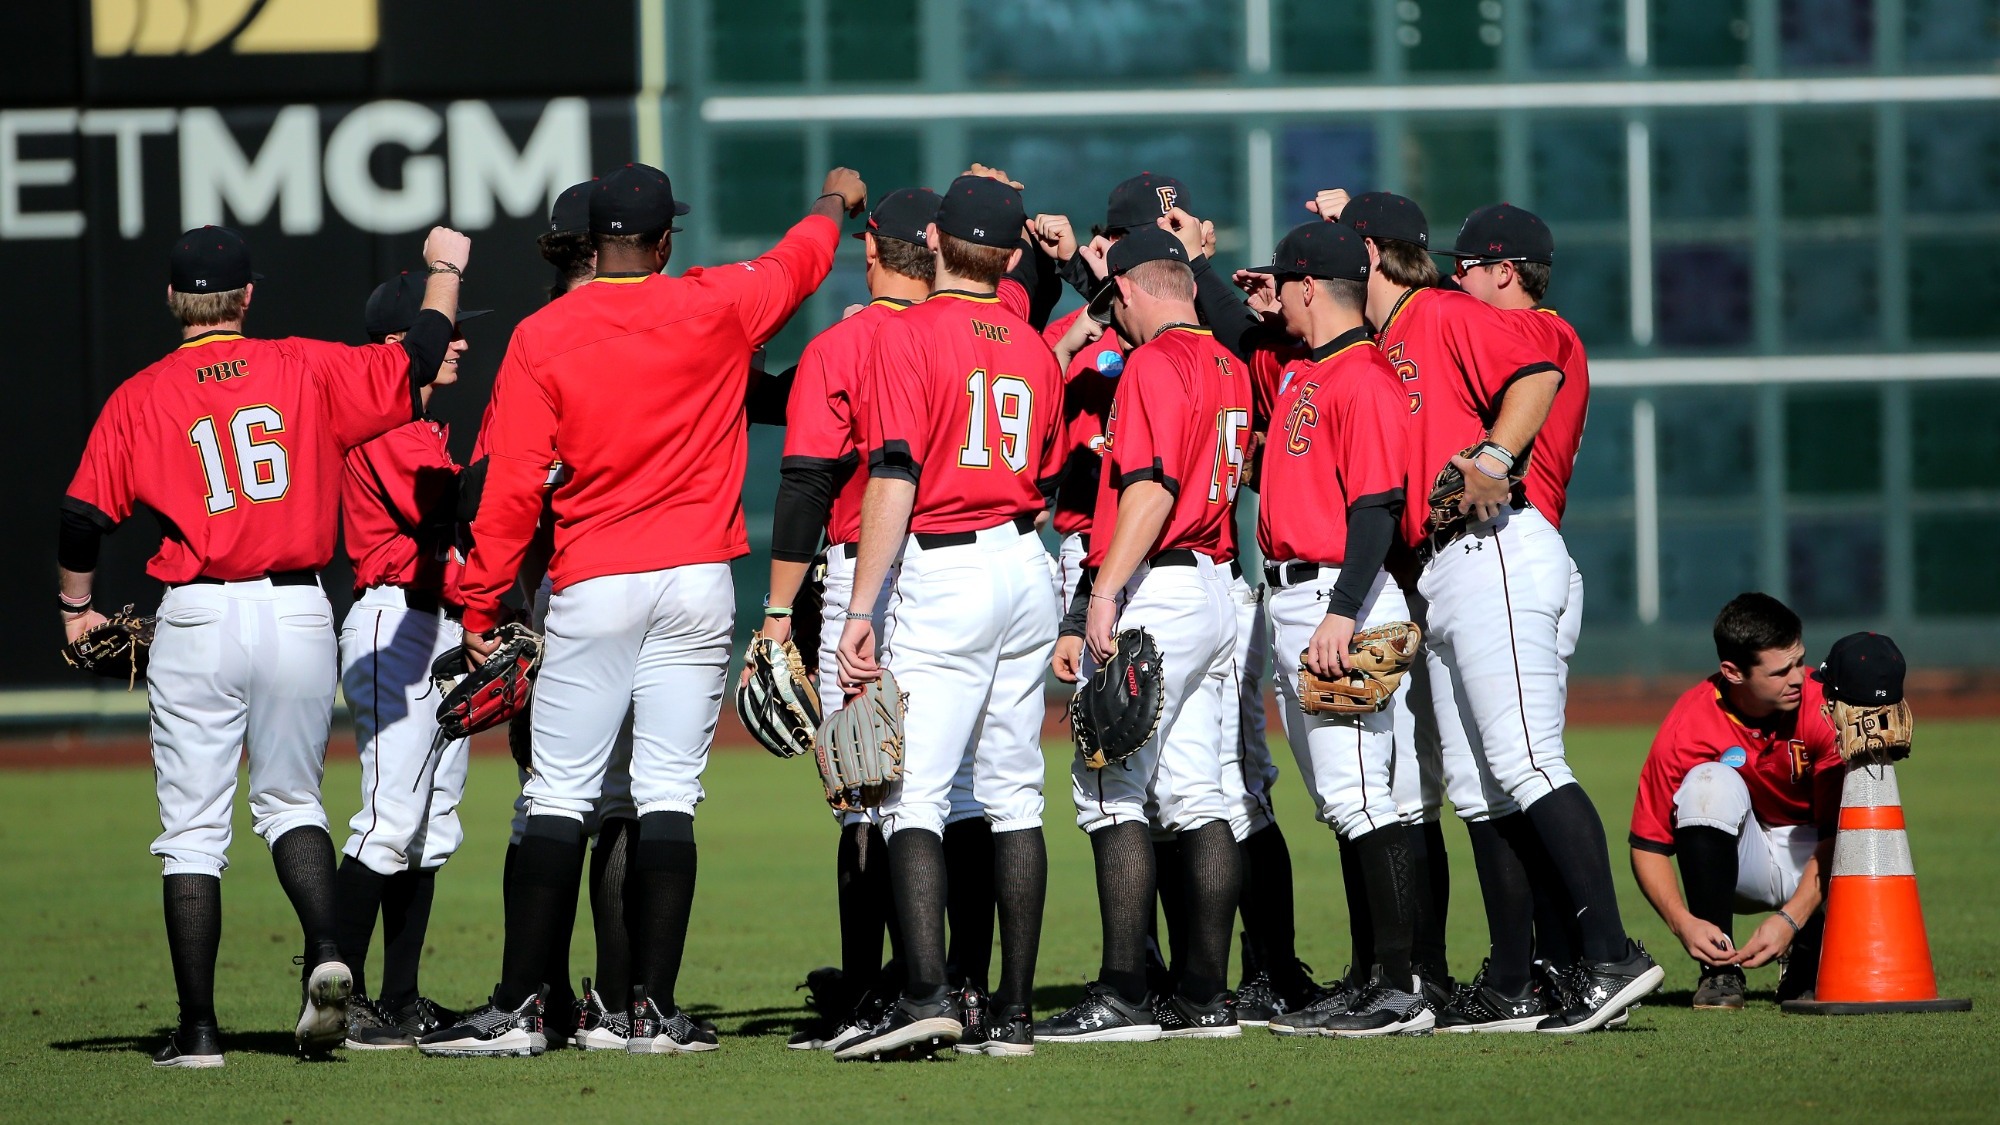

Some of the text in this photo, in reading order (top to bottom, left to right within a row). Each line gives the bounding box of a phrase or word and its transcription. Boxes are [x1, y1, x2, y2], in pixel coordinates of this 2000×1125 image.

[1156, 186, 1178, 214] F
[611, 221, 622, 229] PS
[916, 230, 927, 239] PS
[973, 228, 985, 237] PS
[195, 279, 207, 287] PS
[970, 318, 1012, 344] PBC
[195, 359, 250, 384] PBC
[957, 367, 1034, 476] 19
[187, 402, 291, 518] 16
[1208, 407, 1249, 506] 15
[1128, 664, 1138, 696] A2000
[1875, 689, 1887, 697] PS
